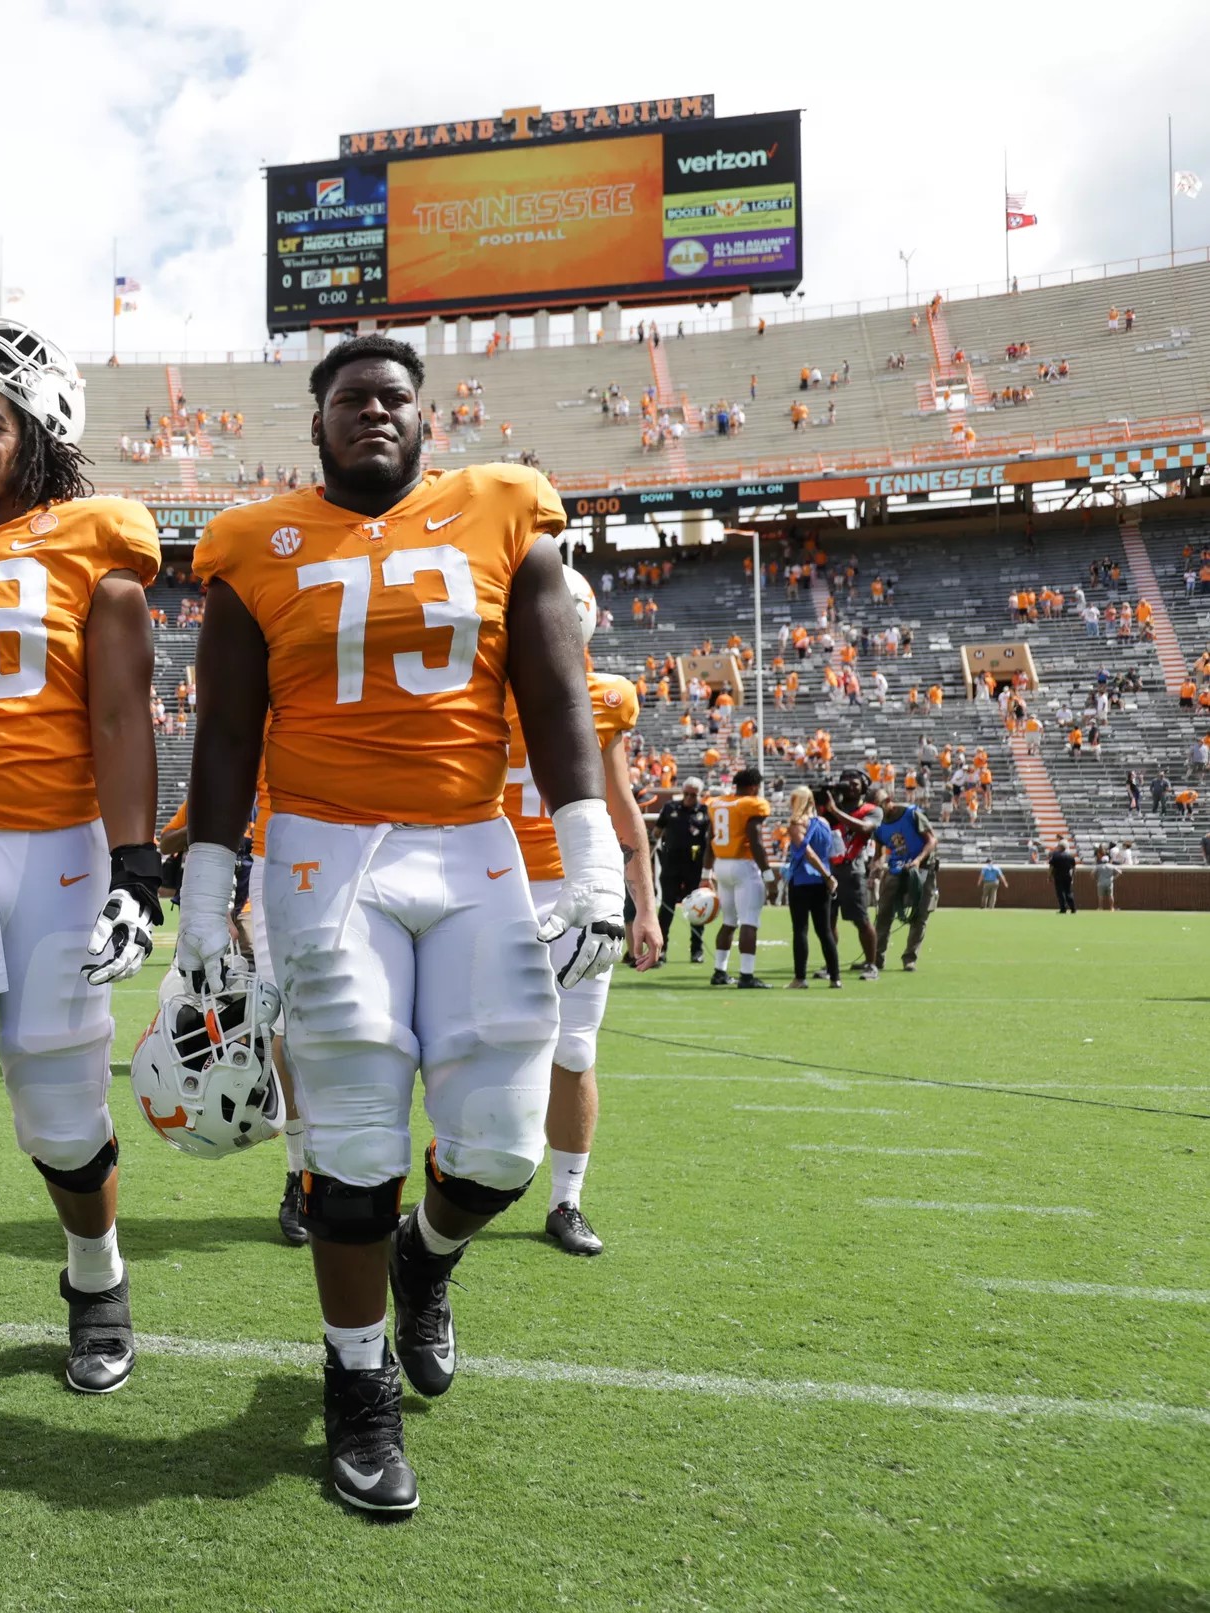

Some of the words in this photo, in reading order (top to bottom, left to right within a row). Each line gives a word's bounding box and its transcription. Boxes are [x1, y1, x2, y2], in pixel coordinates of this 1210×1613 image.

[350, 119, 494, 154] NEYLAND
[502, 106, 541, 140] T
[549, 96, 702, 132] STADIUM
[677, 149, 767, 174] verizon
[276, 209, 309, 225] FIRST
[310, 202, 385, 221] TENNESSEE
[412, 183, 635, 235] TENNESSEE
[752, 200, 778, 211] LOSE
[302, 239, 345, 251] MEDICAL
[347, 234, 385, 248] CENTER
[480, 229, 566, 246] FOOTBALL
[282, 274, 292, 288] 0
[364, 266, 382, 281] 24
[319, 290, 347, 304] 0:00
[866, 465, 1007, 495] TENNESSEE
[577, 498, 620, 515] 0:00
[640, 492, 674, 503] DOWN
[690, 490, 704, 499] TO
[707, 488, 723, 498] GO
[737, 484, 764, 496] BALL
[767, 483, 784, 494] ON
[270, 526, 302, 556] SEC
[296, 544, 482, 705] 73
[714, 807, 729, 846] 8
[292, 860, 321, 893] T
